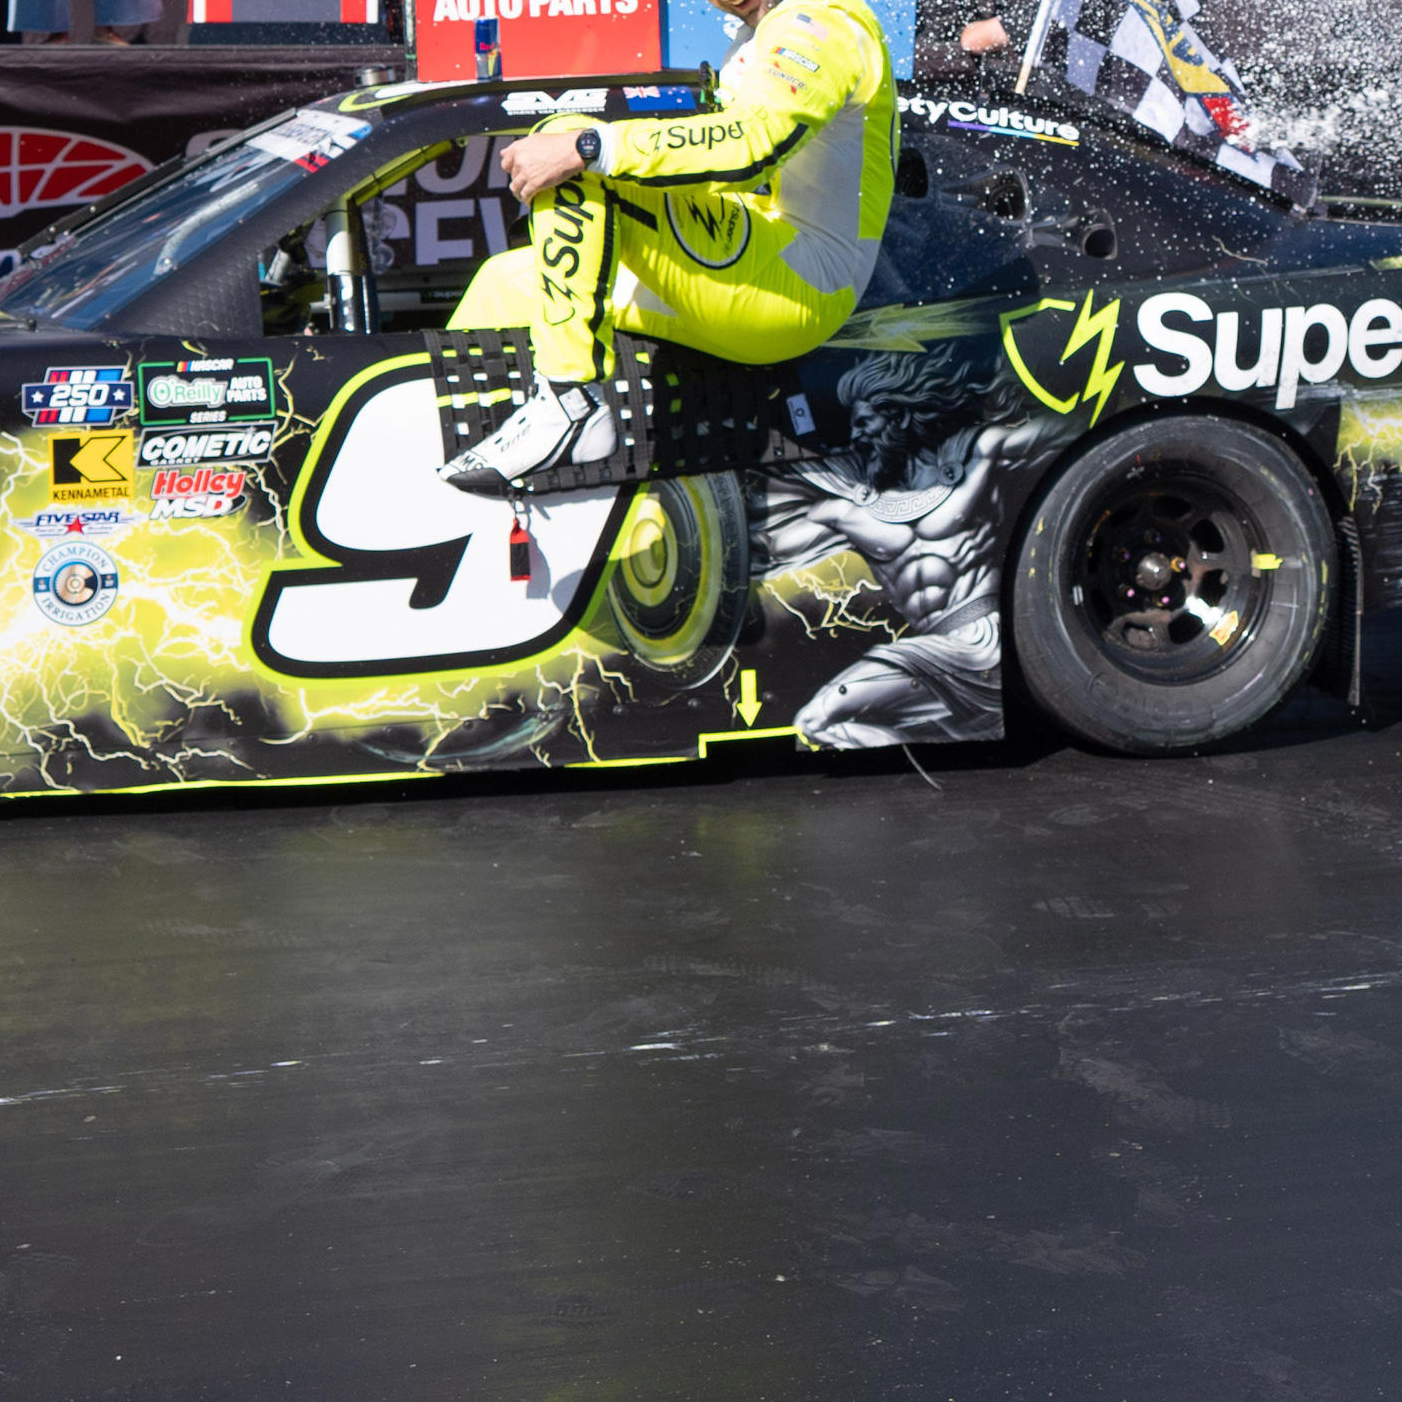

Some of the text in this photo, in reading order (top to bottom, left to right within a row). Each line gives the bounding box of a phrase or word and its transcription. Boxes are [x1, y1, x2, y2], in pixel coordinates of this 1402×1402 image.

[897, 96, 1080, 141] etyCulture
[190, 358, 234, 372] NASCAR
[49, 384, 110, 407] 250
[152, 380, 223, 406] O'Reilly
[226, 387, 267, 402] PARTS
[229, 376, 263, 390] AUTO
[189, 411, 227, 423] SERIES
[141, 430, 272, 461] COMETIC
[53, 486, 130, 501] KENNAMETAL
[151, 468, 247, 499] Holley
[36, 511, 120, 526] FIVE STAR
[150, 495, 234, 520] MSD
[253, 360, 636, 680] 9
[42, 546, 108, 573] CHAMPION
[41, 593, 110, 621] IRRIGATION
